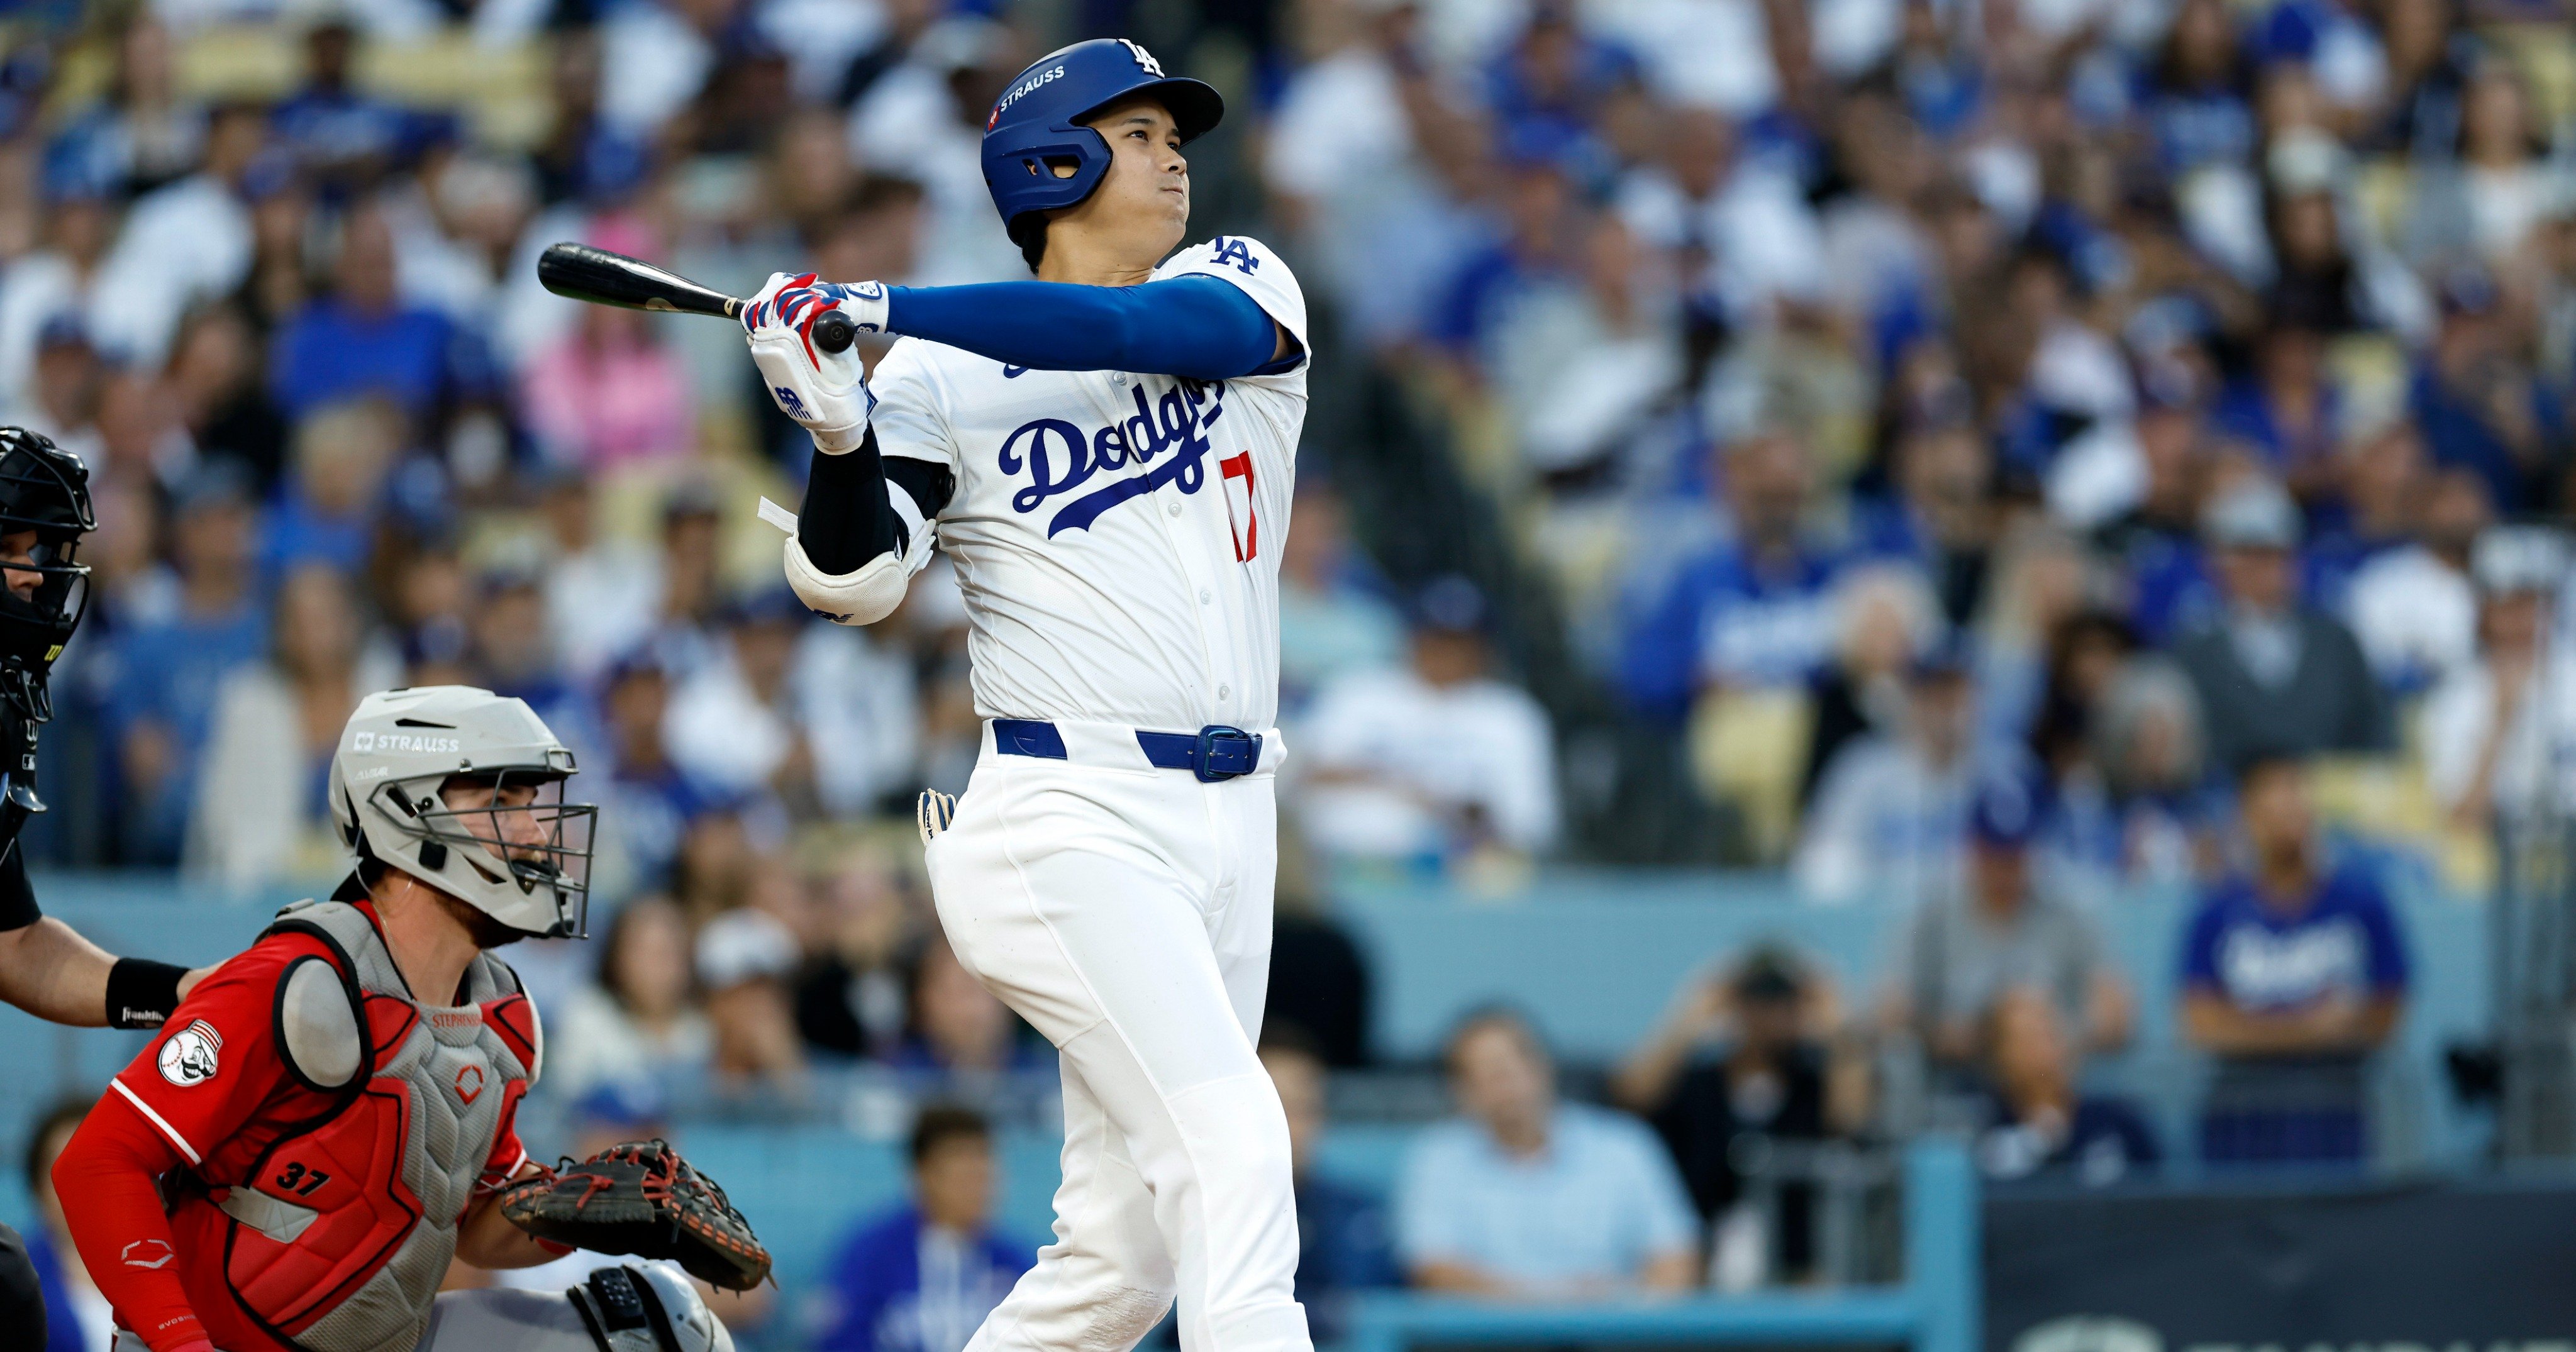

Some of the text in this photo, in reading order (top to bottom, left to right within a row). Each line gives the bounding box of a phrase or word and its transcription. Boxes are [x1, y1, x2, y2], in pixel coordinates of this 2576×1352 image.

[1118, 38, 1165, 79] LA
[1000, 65, 1065, 113] STRAUSS
[1209, 236, 1260, 277] LA
[997, 377, 1226, 516] Dodg
[377, 734, 460, 753] STRAUSS
[275, 1161, 331, 1197] 37
